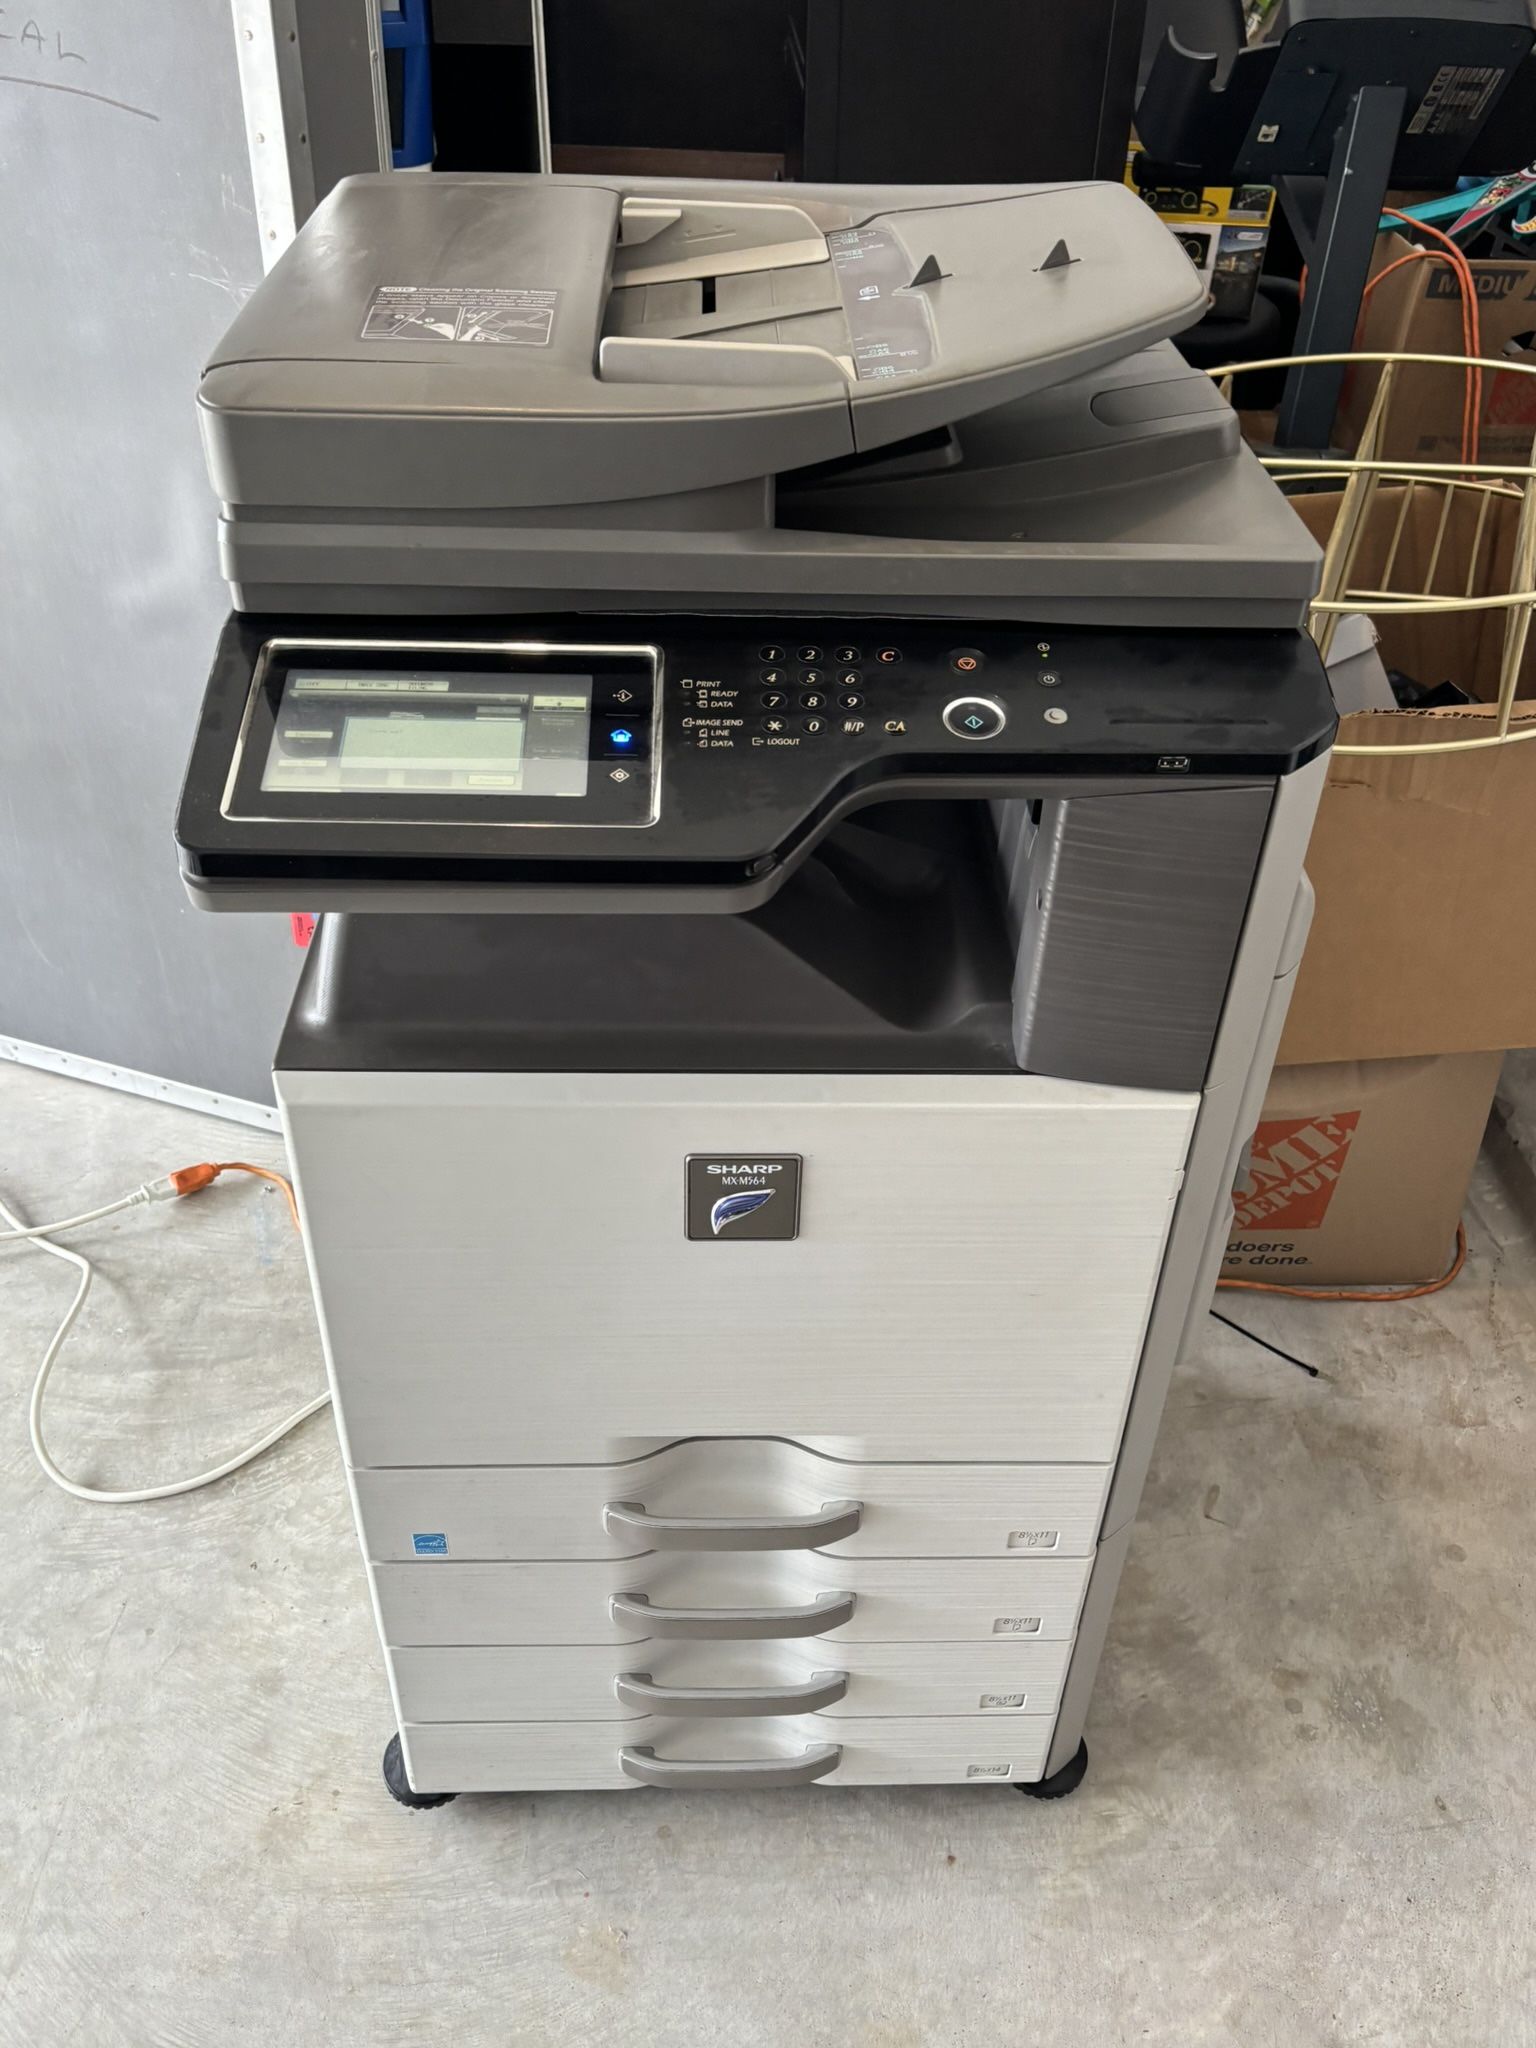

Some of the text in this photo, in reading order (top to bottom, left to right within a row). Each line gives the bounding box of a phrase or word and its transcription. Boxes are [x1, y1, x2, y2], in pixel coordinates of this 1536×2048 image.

[768, 651, 775, 660] 1
[805, 651, 815, 660] 2
[843, 651, 853, 660] 3
[882, 651, 895, 661] C
[766, 673, 777, 683] 4
[806, 673, 816, 683] 5
[845, 673, 855, 683] 6
[769, 696, 779, 706] 7
[807, 696, 818, 707] 8
[847, 697, 858, 707] 9
[809, 721, 819, 732] 0
[884, 721, 906, 732] CA
[710, 740, 734, 748] DATA
[767, 738, 800, 746] LOGOUT
[706, 1164, 783, 1174] SHARP
[721, 1176, 766, 1185] MX-M564
[1226, 1240, 1295, 1252] doers
